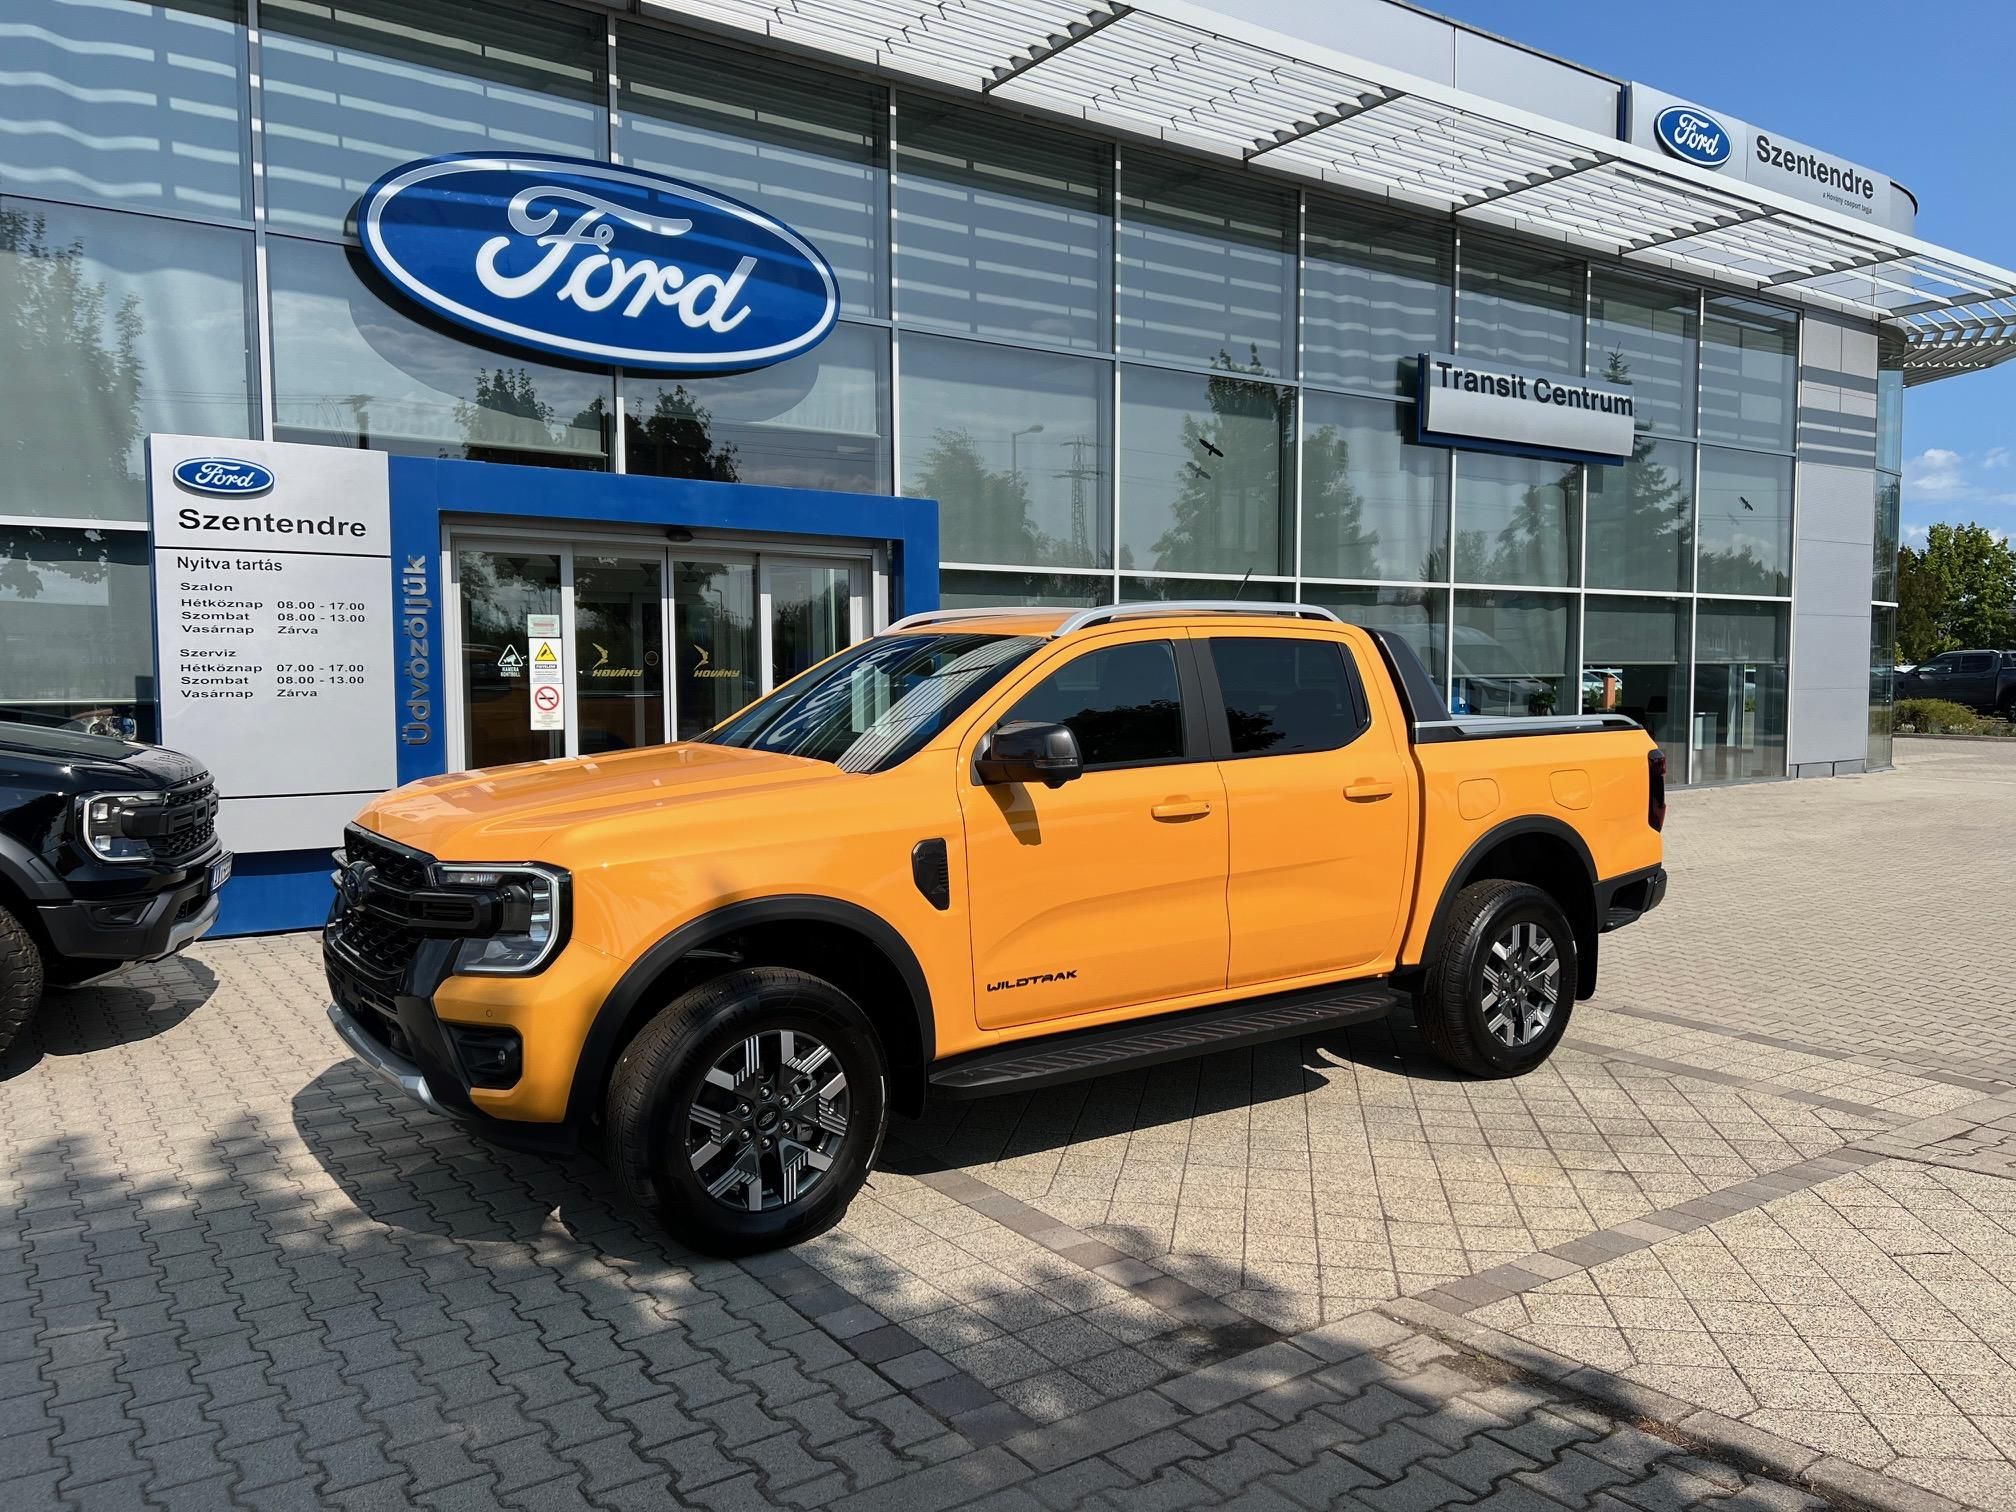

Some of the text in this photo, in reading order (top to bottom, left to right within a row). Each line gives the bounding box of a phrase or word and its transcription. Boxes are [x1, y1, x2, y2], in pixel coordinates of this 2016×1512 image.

[1674, 113, 1720, 156] Ford
[1756, 134, 1874, 199] Szentendre
[475, 186, 757, 333] Ford
[1437, 361, 1633, 416] Transit Centrum
[195, 462, 254, 487] Ford
[178, 508, 367, 537] Szentendre
[177, 556, 283, 572] Nyitva tartás
[180, 582, 233, 592] Szalon
[181, 598, 263, 610] Hétköznap
[277, 600, 315, 610] 08.00
[329, 602, 365, 611] 17.00
[181, 611, 250, 621] Szombat
[277, 613, 316, 622] 08.00
[329, 614, 366, 623] 13.00
[181, 624, 319, 635] Vasárnap Zárva
[179, 648, 237, 658] Szerviz
[402, 555, 433, 745] Üdvözöljük
[180, 663, 263, 674] Hétköznap
[276, 664, 315, 673] 07.00
[328, 664, 364, 672] 17.00
[592, 667, 643, 677] HOVÁNY
[693, 668, 740, 678] HOVÁNY
[180, 676, 249, 685] Szombat
[276, 676, 315, 685] 08.00
[328, 676, 365, 684] 13.00
[180, 688, 318, 700] Vasárnap Zárva
[986, 969, 1078, 992] WILDTRAK
